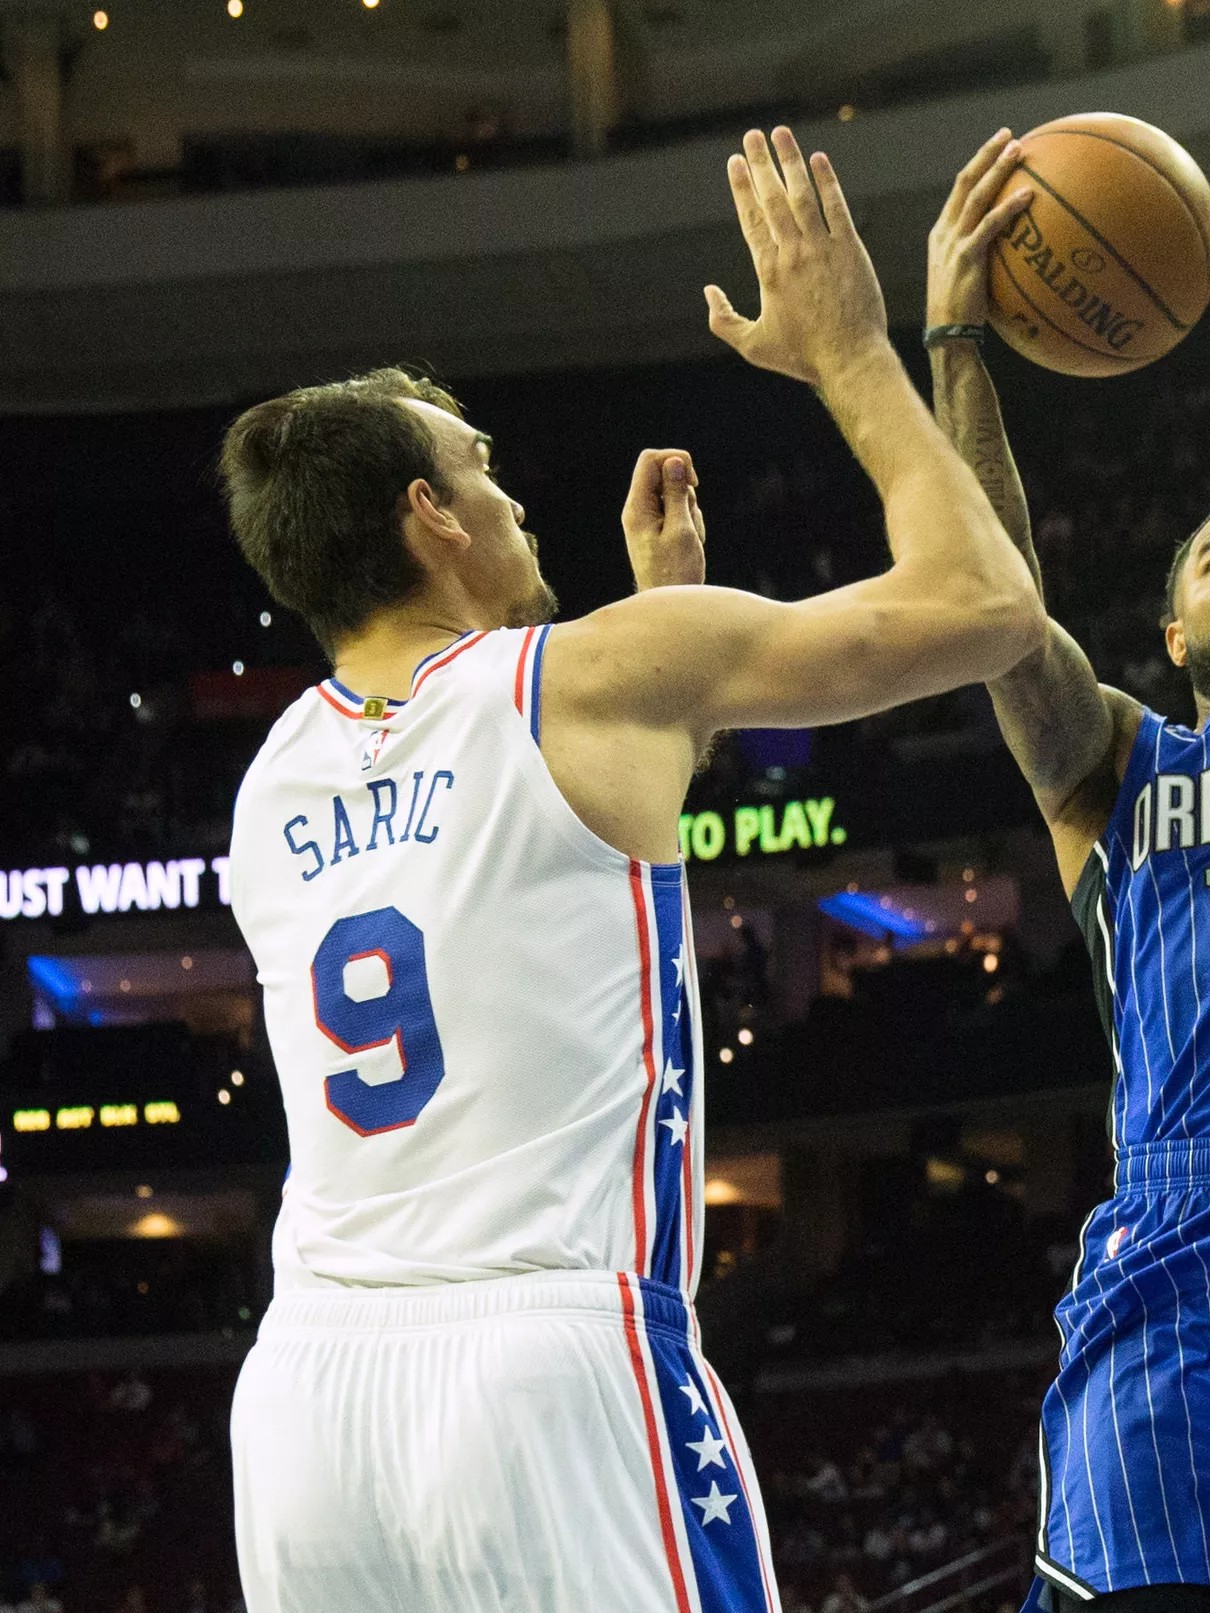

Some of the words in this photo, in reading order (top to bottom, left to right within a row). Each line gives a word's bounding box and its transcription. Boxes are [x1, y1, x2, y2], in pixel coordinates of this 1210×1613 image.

[283, 770, 454, 882] SARIC
[679, 811, 726, 862] TO
[735, 797, 847, 857] PLAY.
[0, 867, 70, 919] UST
[75, 857, 206, 914] WANT
[211, 856, 232, 906] T
[310, 905, 446, 1138] 9
